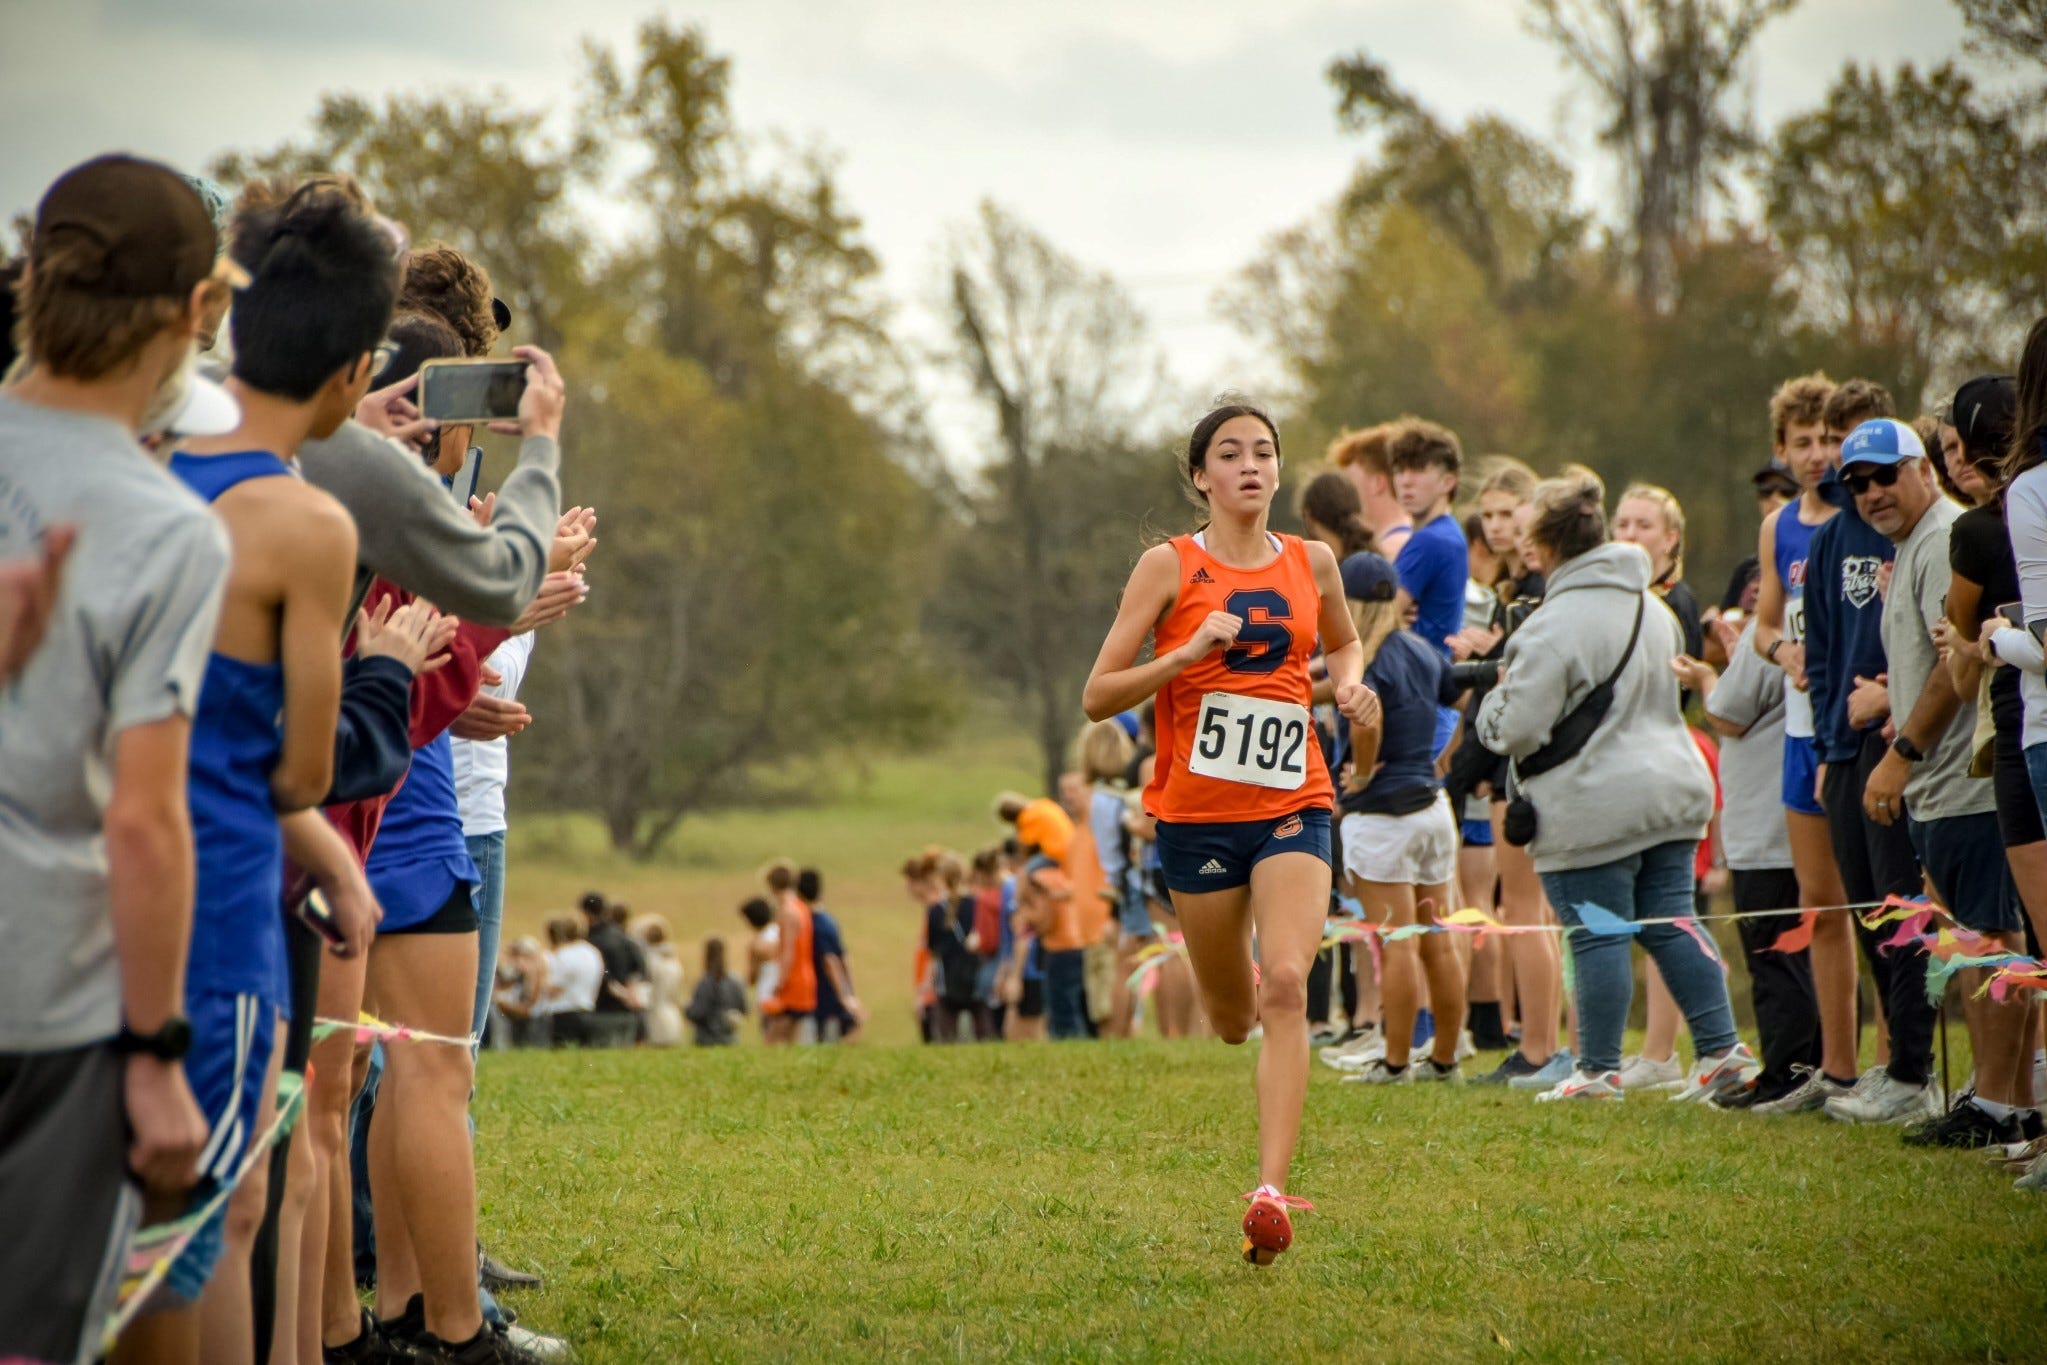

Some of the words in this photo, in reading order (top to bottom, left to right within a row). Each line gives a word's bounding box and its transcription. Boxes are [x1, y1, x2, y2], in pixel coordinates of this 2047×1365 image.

[1223, 587, 1294, 675] S
[1199, 706, 1304, 774] 5192
[1198, 867, 1227, 875] adidas
